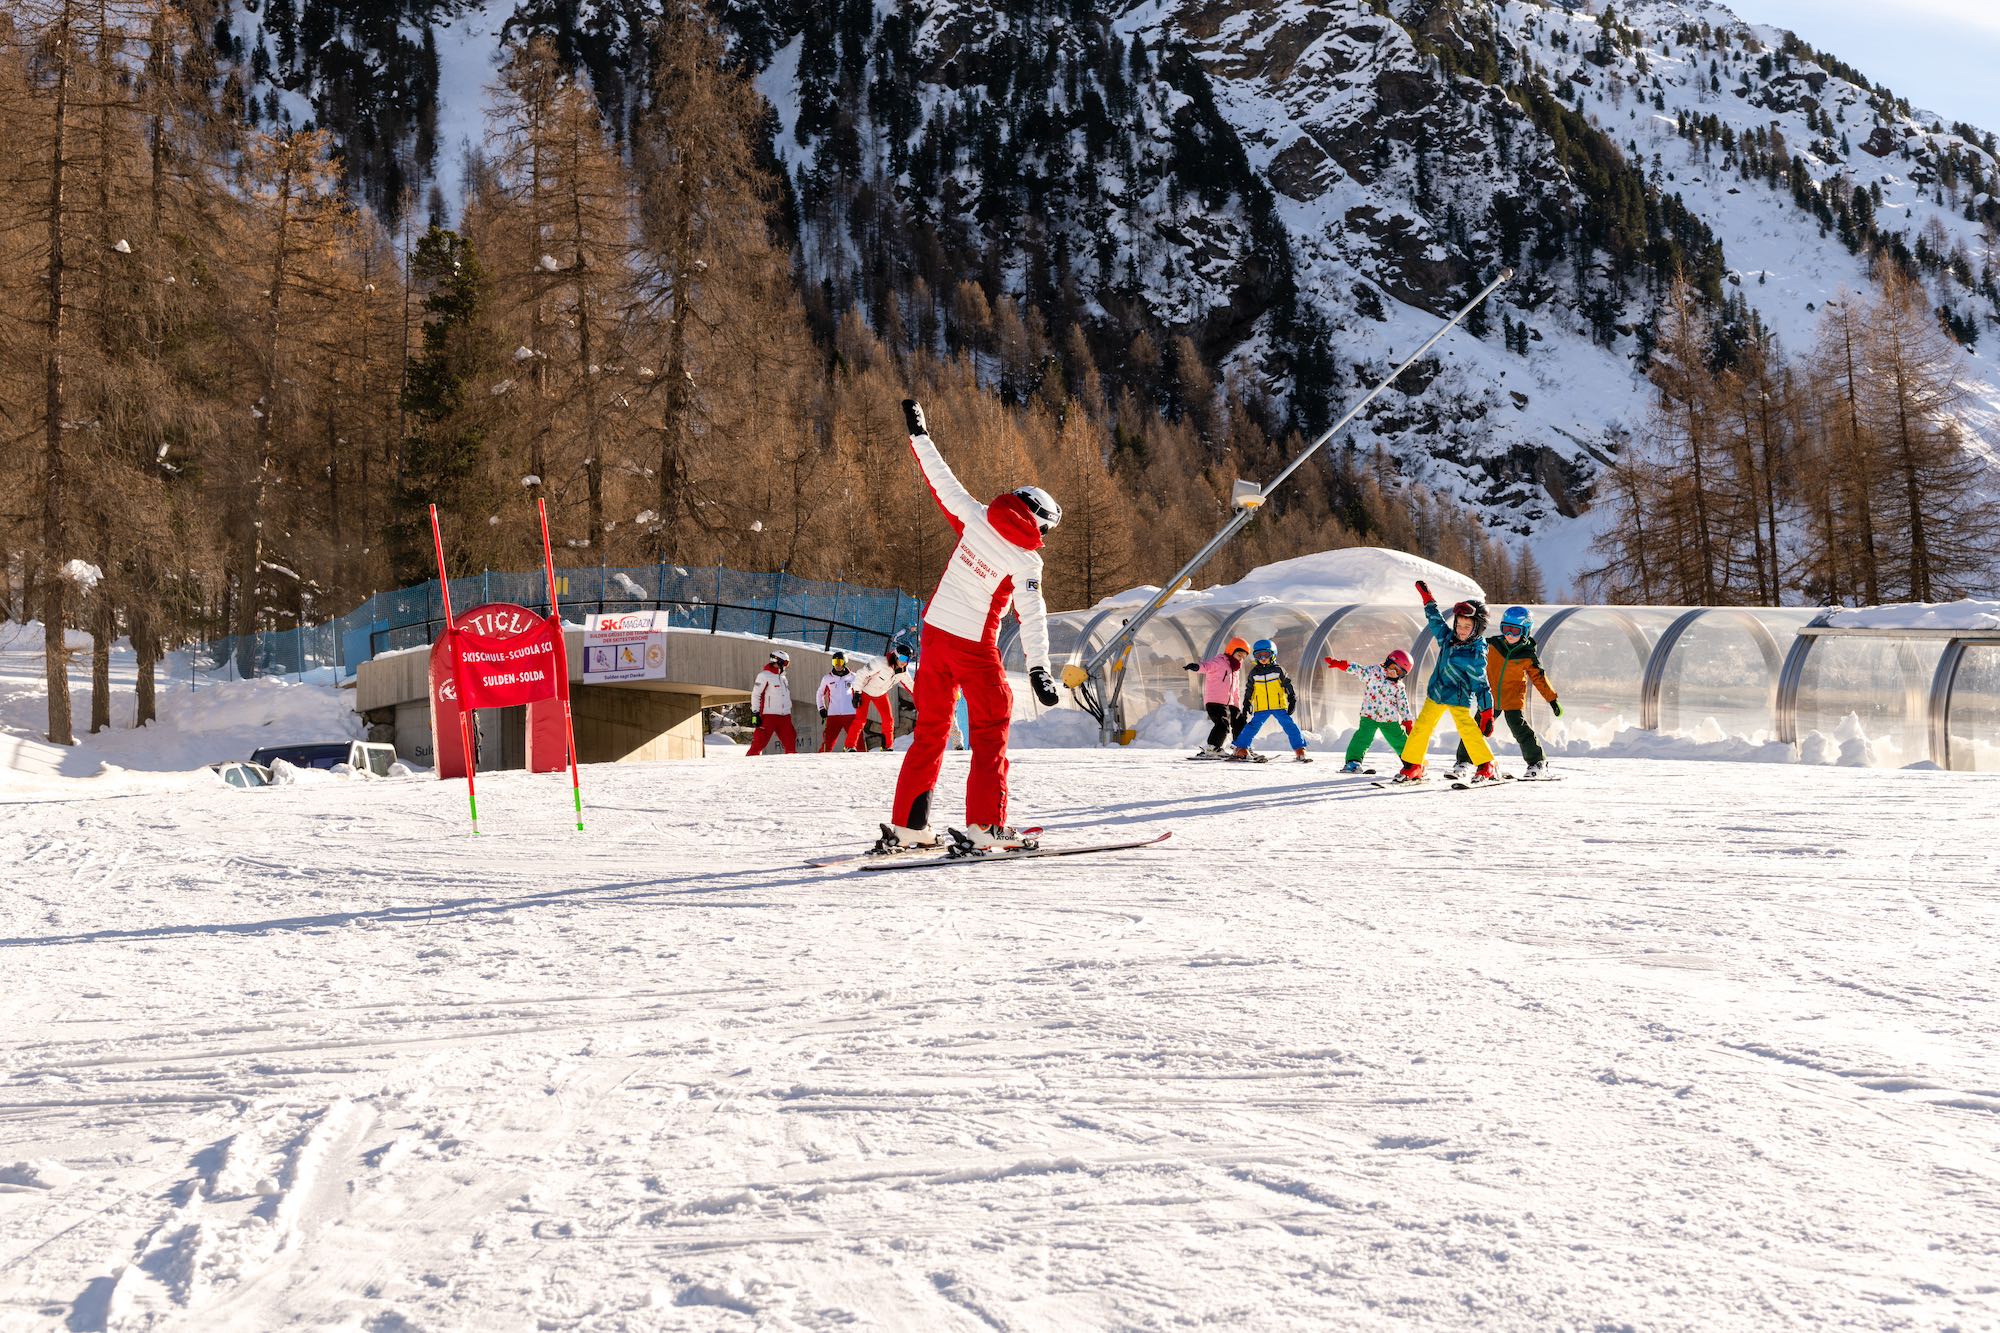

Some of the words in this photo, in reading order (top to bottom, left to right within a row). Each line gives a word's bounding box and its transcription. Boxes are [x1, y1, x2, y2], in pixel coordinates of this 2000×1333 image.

[959, 553, 973, 568] SULDEN
[973, 566, 987, 579] SOLDA
[990, 570, 998, 578] SCI
[541, 641, 553, 653] SCI
[482, 670, 545, 687] SULDEN-SOLDA
[775, 737, 804, 751] RM
